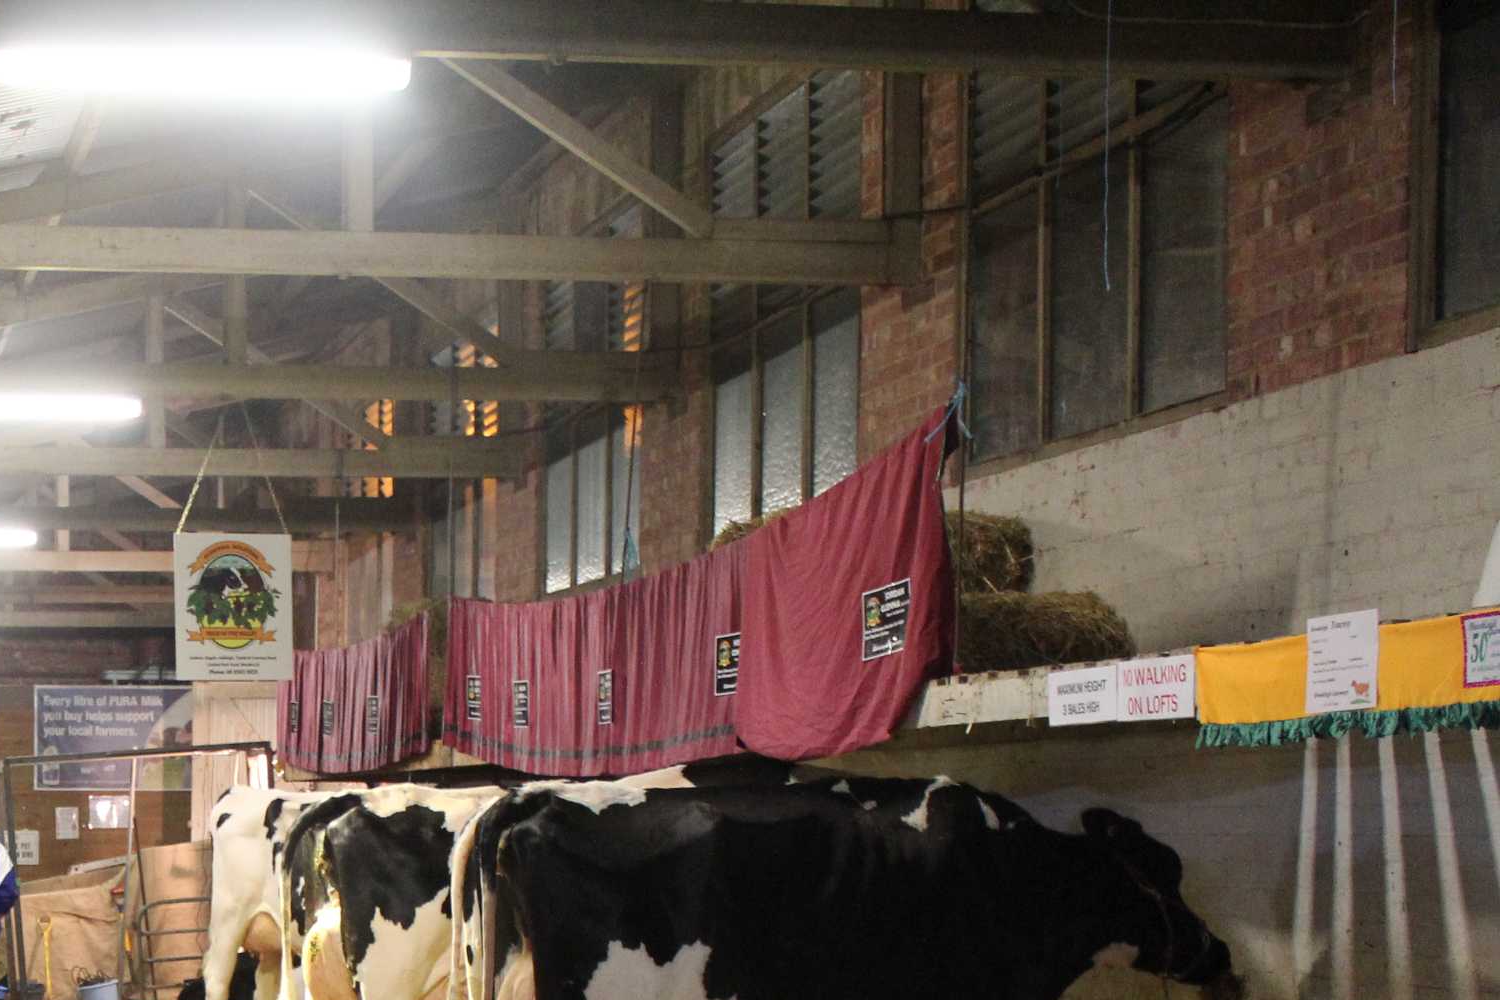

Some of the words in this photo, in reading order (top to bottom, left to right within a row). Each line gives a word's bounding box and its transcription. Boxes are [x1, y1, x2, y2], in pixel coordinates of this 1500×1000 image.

[1134, 664, 1187, 685] WALKING
[1084, 679, 1107, 693] HEIGHT
[43, 695, 71, 707] Every
[74, 695, 95, 706] litre
[96, 695, 107, 706] of
[109, 696, 137, 706] PURA
[141, 696, 163, 706] Milk
[1068, 703, 1086, 715] BALES
[1087, 701, 1100, 713] HIGH
[1128, 697, 1143, 715] ON
[1147, 694, 1178, 714] LOFTS
[43, 712, 62, 722] you
[64, 711, 82, 723] buy
[85, 711, 113, 723] helps
[115, 712, 154, 723] support
[43, 728, 65, 738] your
[68, 726, 93, 736] local
[95, 726, 138, 736] farmers.
